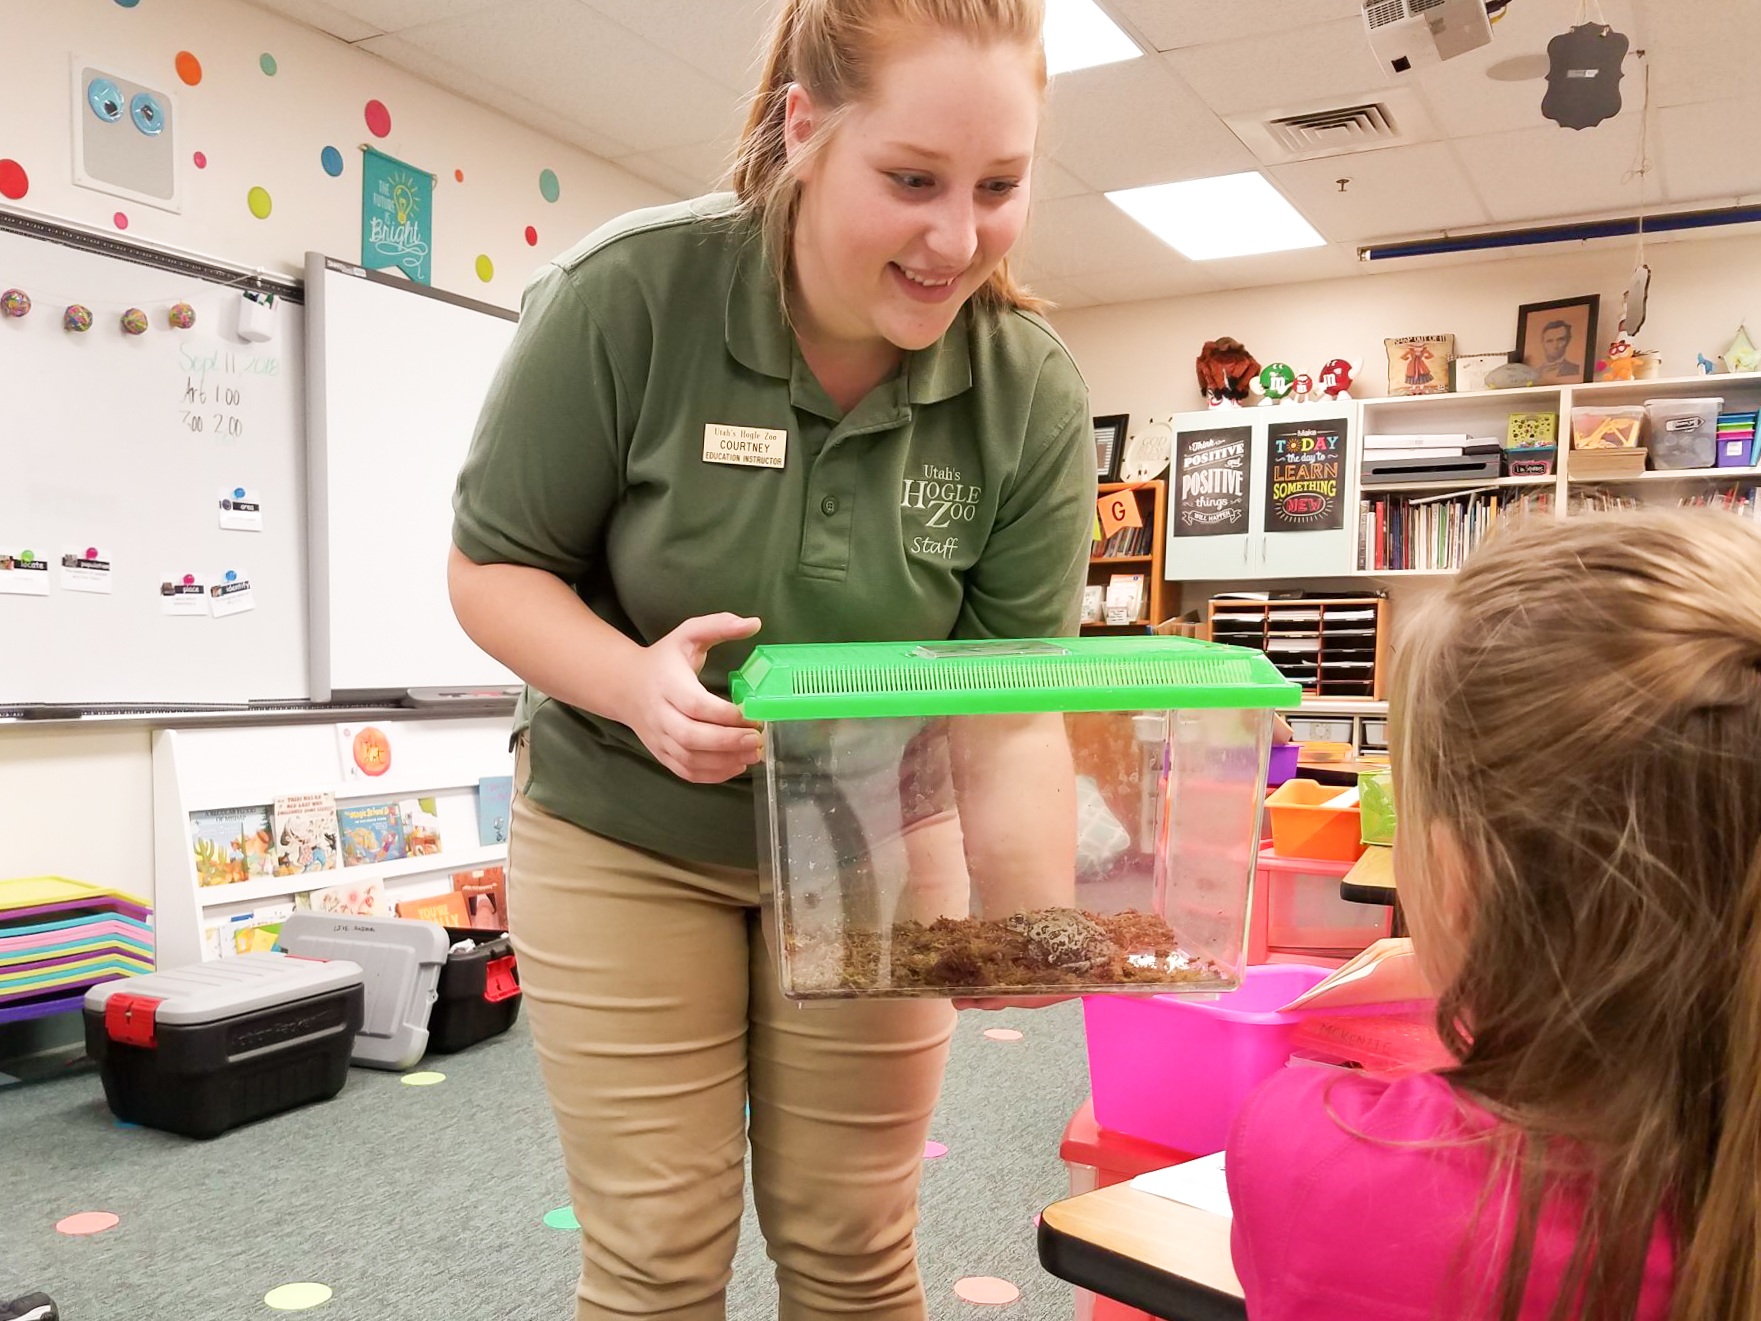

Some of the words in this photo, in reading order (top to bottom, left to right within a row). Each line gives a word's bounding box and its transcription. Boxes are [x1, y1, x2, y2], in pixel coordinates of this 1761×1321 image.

[369, 216, 421, 251] Bright
[180, 375, 207, 404] Art
[714, 427, 736, 437] Utah's
[740, 430, 761, 440] Hogle
[764, 432, 777, 441] Zoo
[720, 439, 770, 453] COURTNEY
[1190, 438, 1215, 451] Think
[705, 451, 740, 462] EDUCATION
[743, 455, 782, 466] INSTRUCTOR
[1184, 443, 1244, 468] POSITIVE
[1286, 453, 1300, 463] the
[1301, 452, 1316, 463] day
[1317, 451, 1326, 461] to
[923, 464, 961, 480] Utah's
[1274, 462, 1339, 481] LEARN
[1182, 468, 1243, 500] POSITIVE
[1273, 480, 1337, 500] SOMETHING
[900, 479, 981, 509] HOGLE
[1112, 501, 1126, 521] G
[1195, 496, 1228, 510] things
[1287, 498, 1321, 512] NEW
[925, 500, 976, 528] ZOO
[1194, 512, 1207, 520] WILL
[1208, 510, 1231, 521] HAPPEN
[911, 536, 958, 560] Staff
[418, 903, 449, 919] YOU'RE
